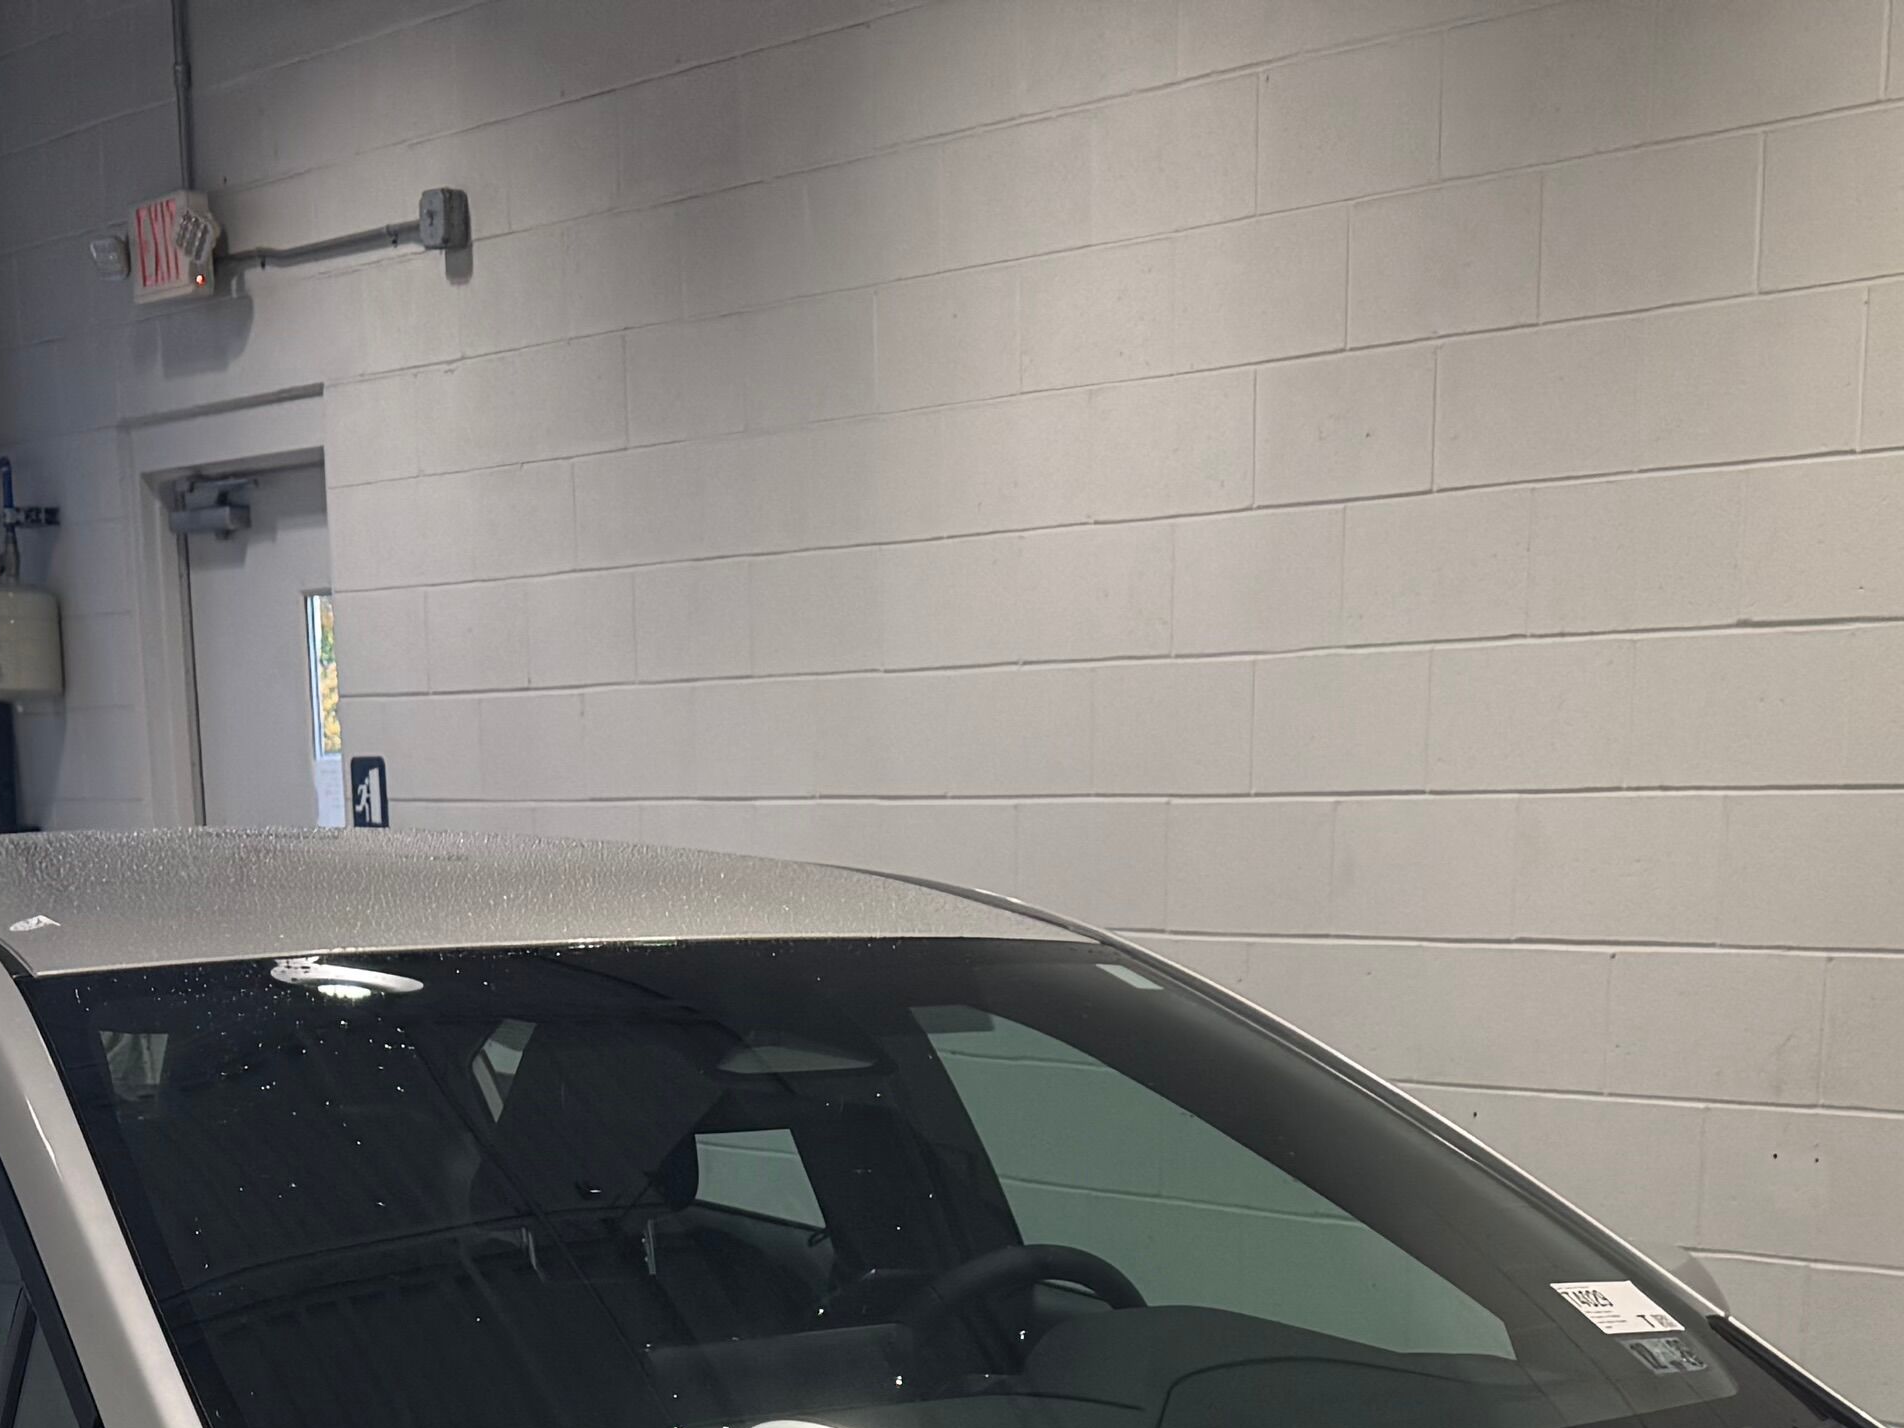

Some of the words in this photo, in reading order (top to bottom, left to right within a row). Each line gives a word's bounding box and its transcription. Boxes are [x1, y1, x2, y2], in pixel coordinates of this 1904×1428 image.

[136, 199, 179, 287] EXIT
[1560, 1289, 1614, 1308] T4029
[1636, 1314, 1656, 1328] T
